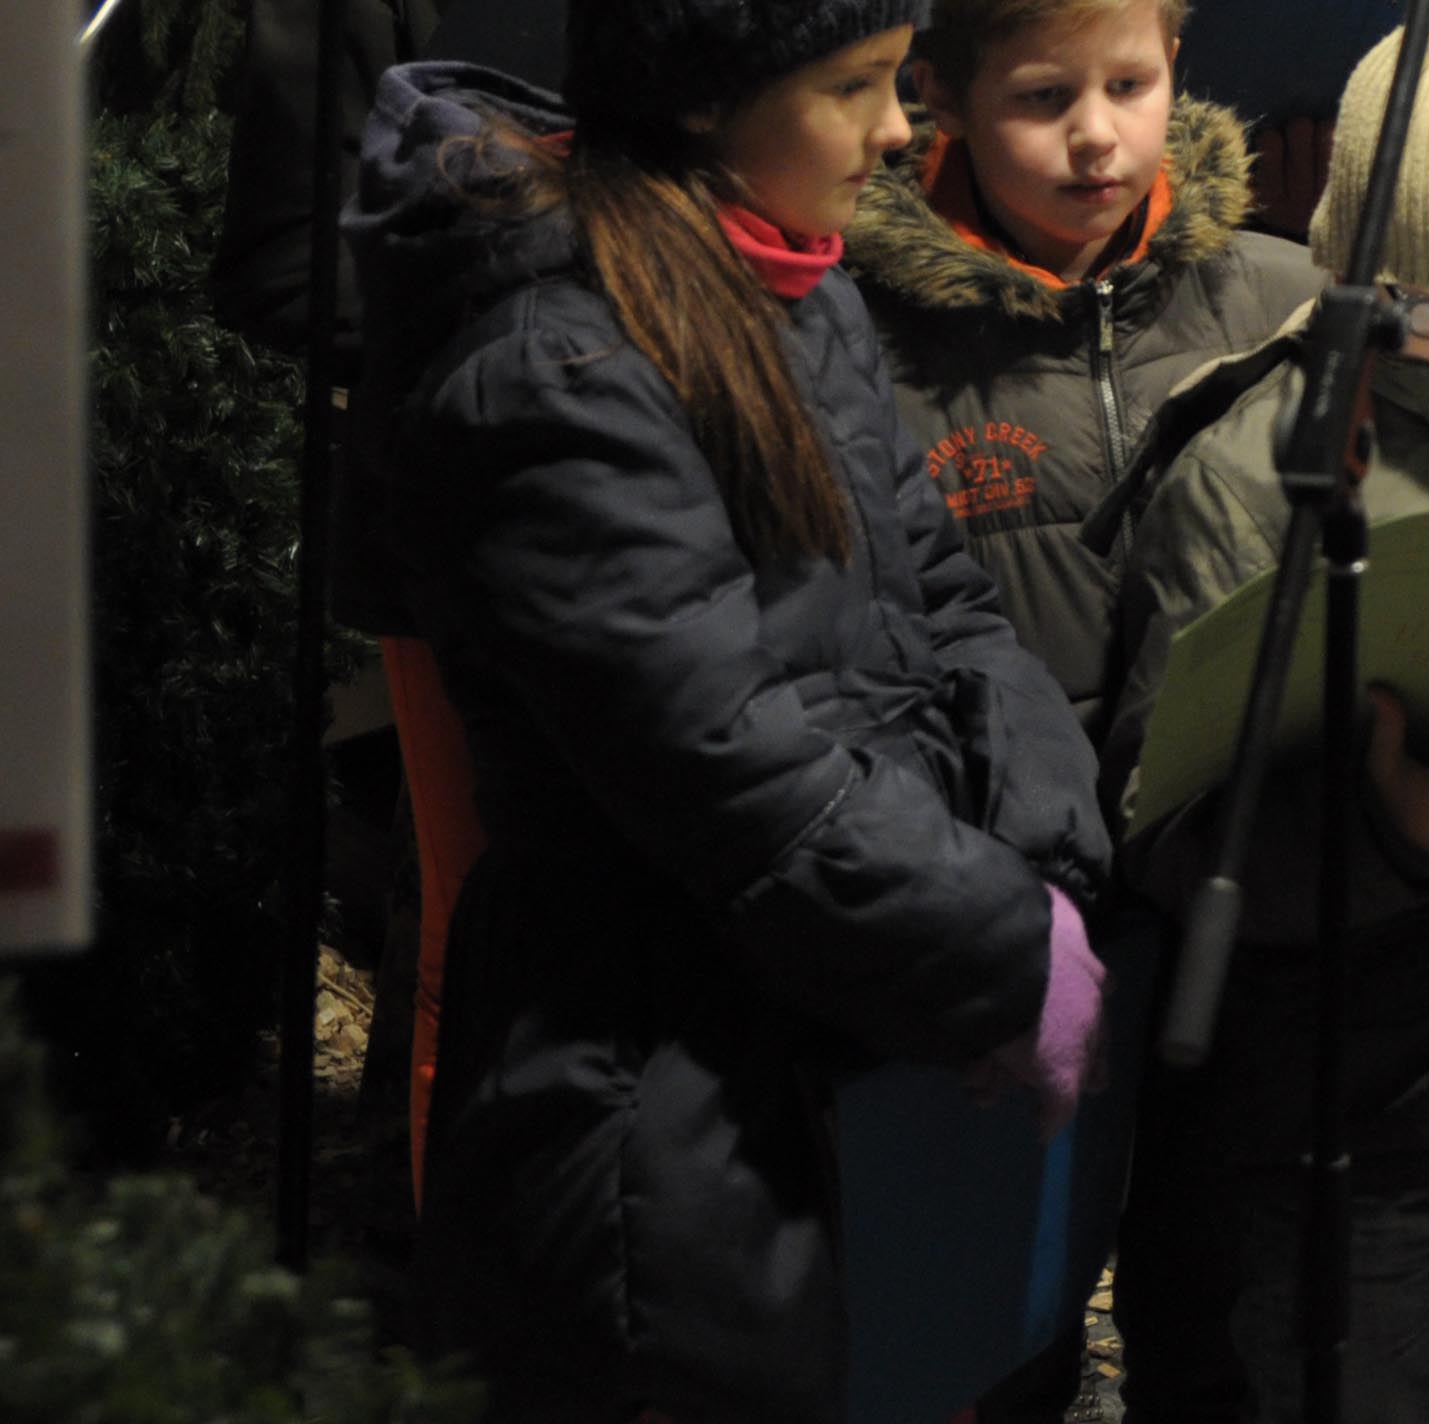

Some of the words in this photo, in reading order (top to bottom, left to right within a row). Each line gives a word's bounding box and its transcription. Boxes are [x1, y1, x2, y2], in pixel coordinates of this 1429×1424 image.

[928, 427, 976, 480] STONY
[984, 421, 1049, 463] CREEK
[973, 455, 1002, 484] 71
